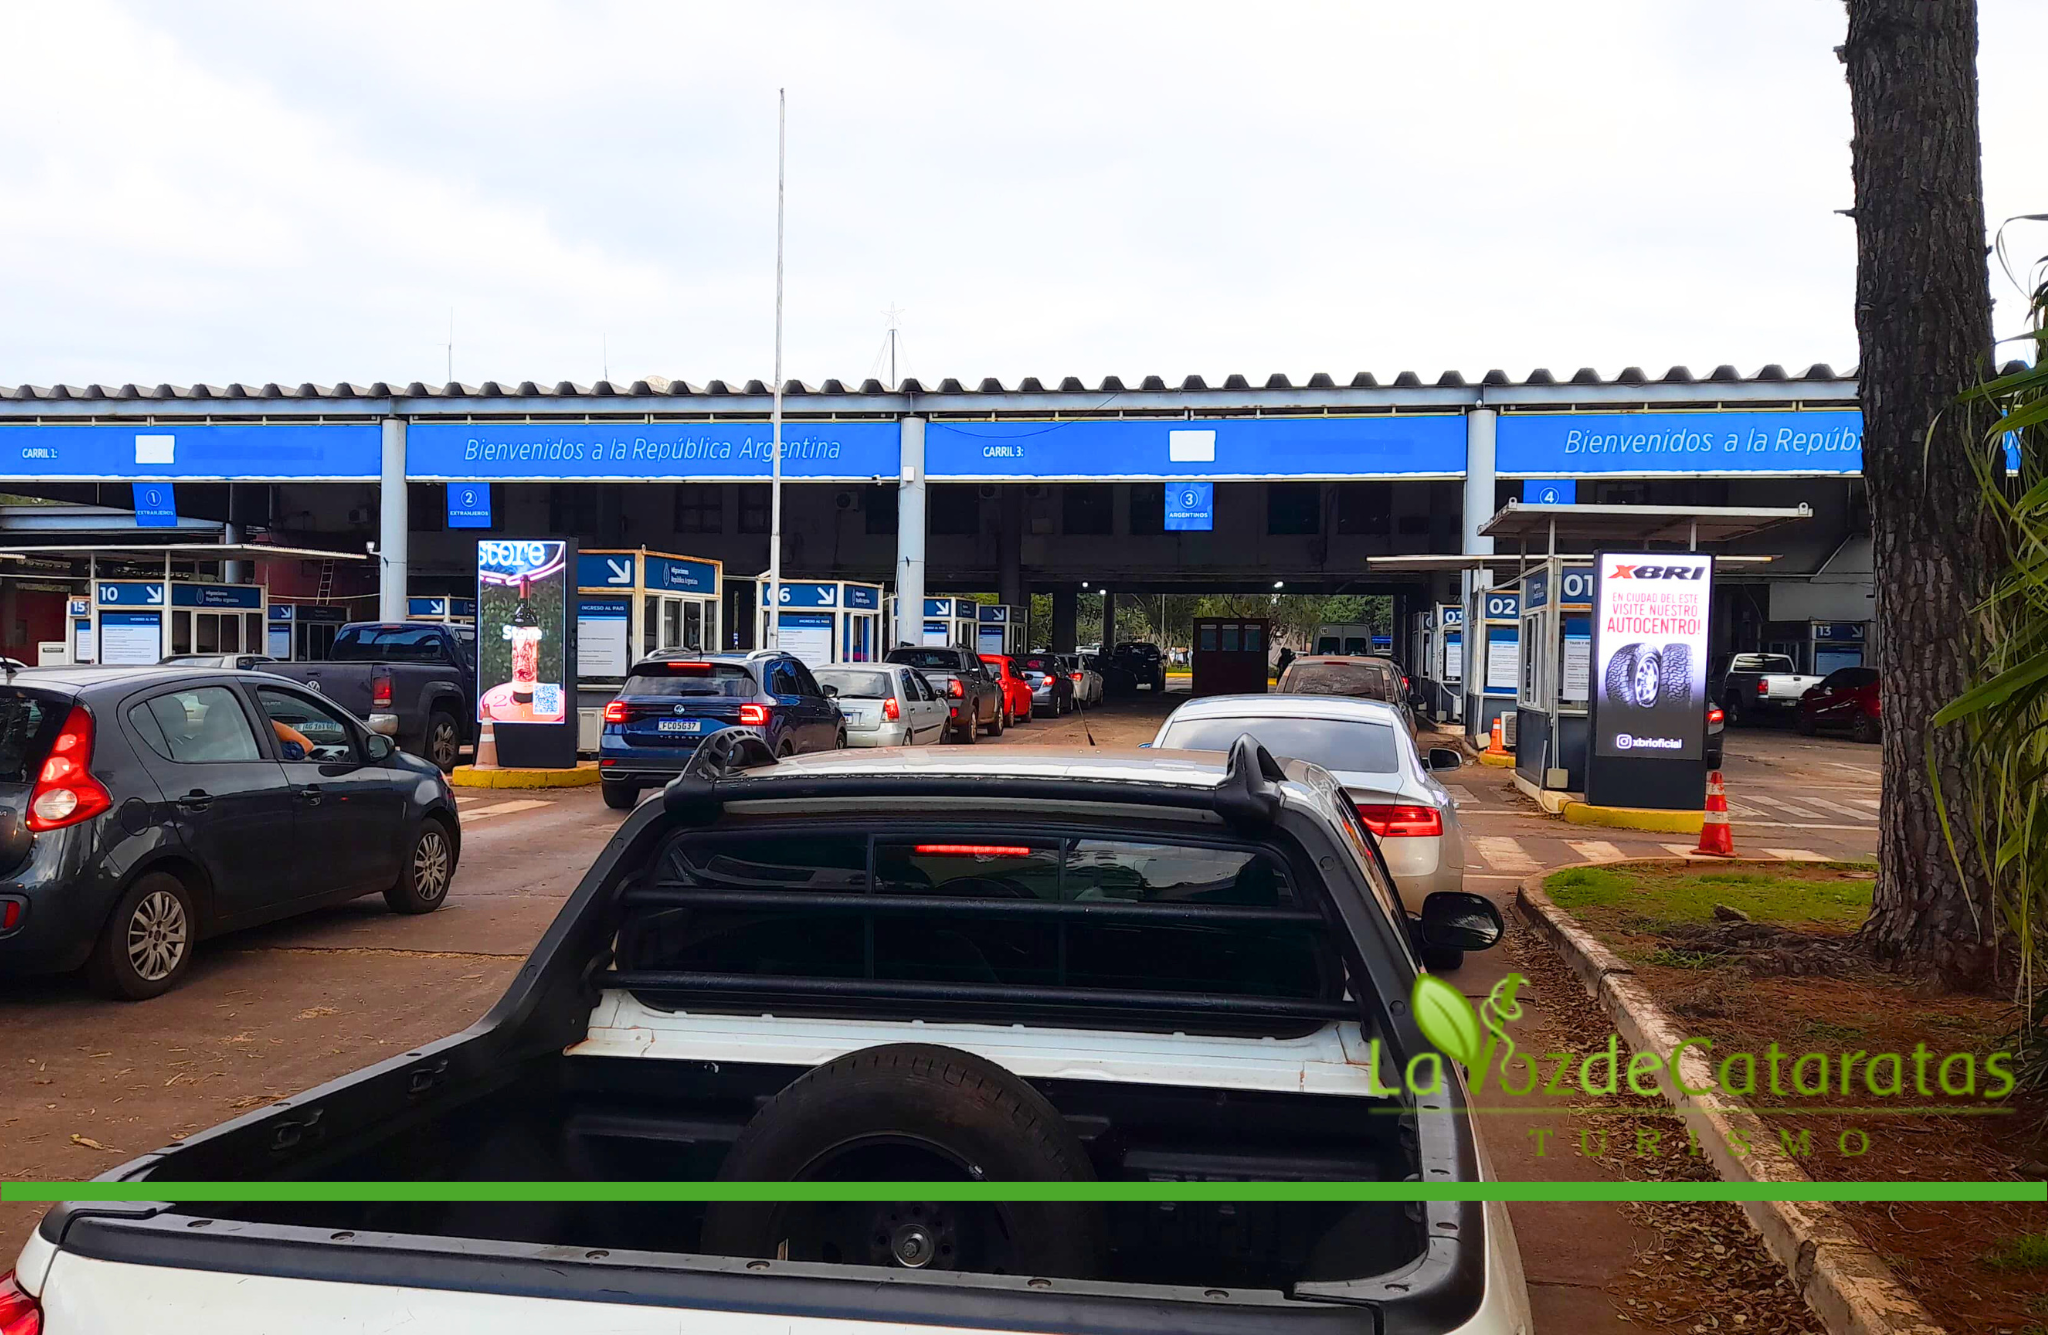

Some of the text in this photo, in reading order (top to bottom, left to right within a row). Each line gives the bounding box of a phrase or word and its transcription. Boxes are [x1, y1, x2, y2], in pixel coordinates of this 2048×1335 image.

[1564, 427, 1713, 454] Bienvenidos
[1723, 433, 1738, 452] a
[1746, 428, 1768, 452] la
[22, 448, 49, 459] CARRIL
[464, 436, 841, 463] Bienvenidos a la República Argentina
[983, 446, 1024, 458] CARRIL 3:
[1608, 564, 1706, 581] XBRI
[1563, 574, 1594, 597] 01
[100, 586, 119, 602] 10
[1612, 592, 1699, 604] EN CIUDAD DEL ESTE
[72, 601, 86, 613] 15
[1489, 598, 1516, 615] 02
[1612, 603, 1698, 618] VISITE NUESTRO
[502, 624, 543, 641] Store
[1607, 617, 1701, 635] AUTOCENTRO!
[1818, 625, 1832, 637] 13
[1632, 737, 1682, 750] xbrioficial
